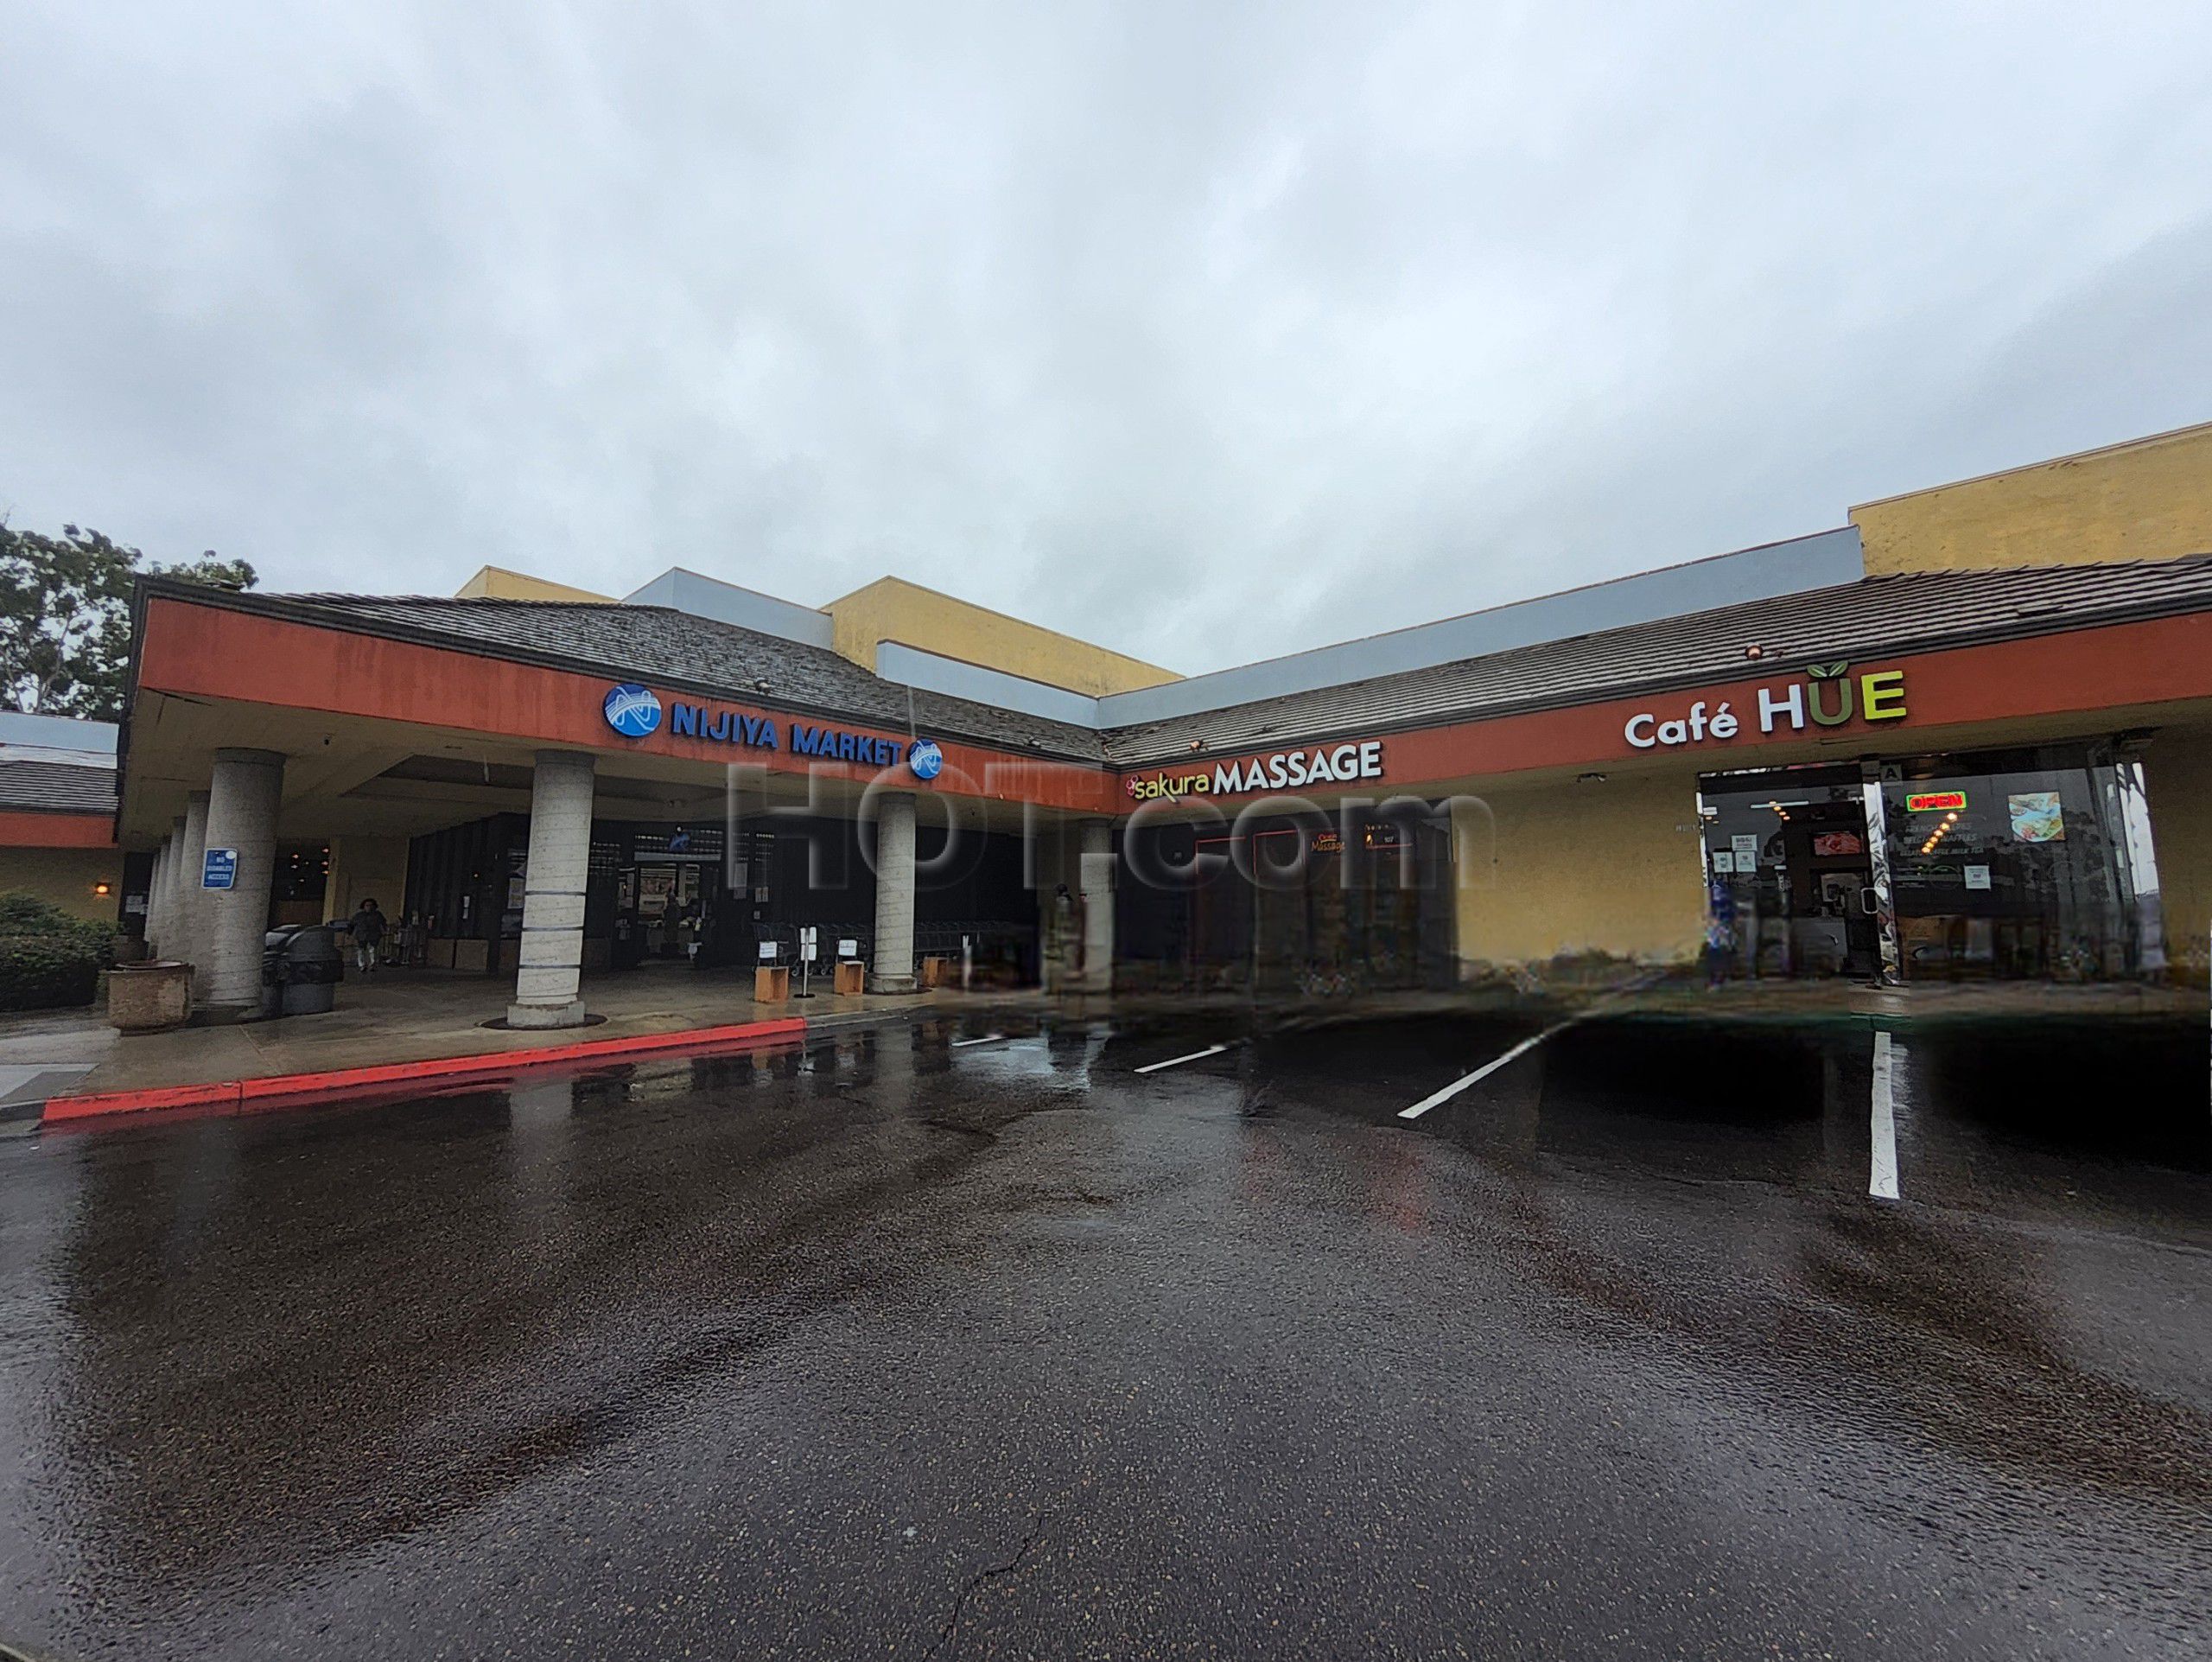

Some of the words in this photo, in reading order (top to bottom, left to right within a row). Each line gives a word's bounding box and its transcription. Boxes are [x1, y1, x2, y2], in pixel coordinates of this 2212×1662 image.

[671, 701, 778, 749] NIJIYA
[790, 723, 903, 767] MARKET
[1624, 701, 1738, 748] Café
[1758, 669, 1906, 733] HUE
[1134, 772, 1210, 803] sakura
[1212, 741, 1382, 795] MASSAGE
[1885, 767, 1897, 778] A
[1910, 793, 1963, 809] OPEN
